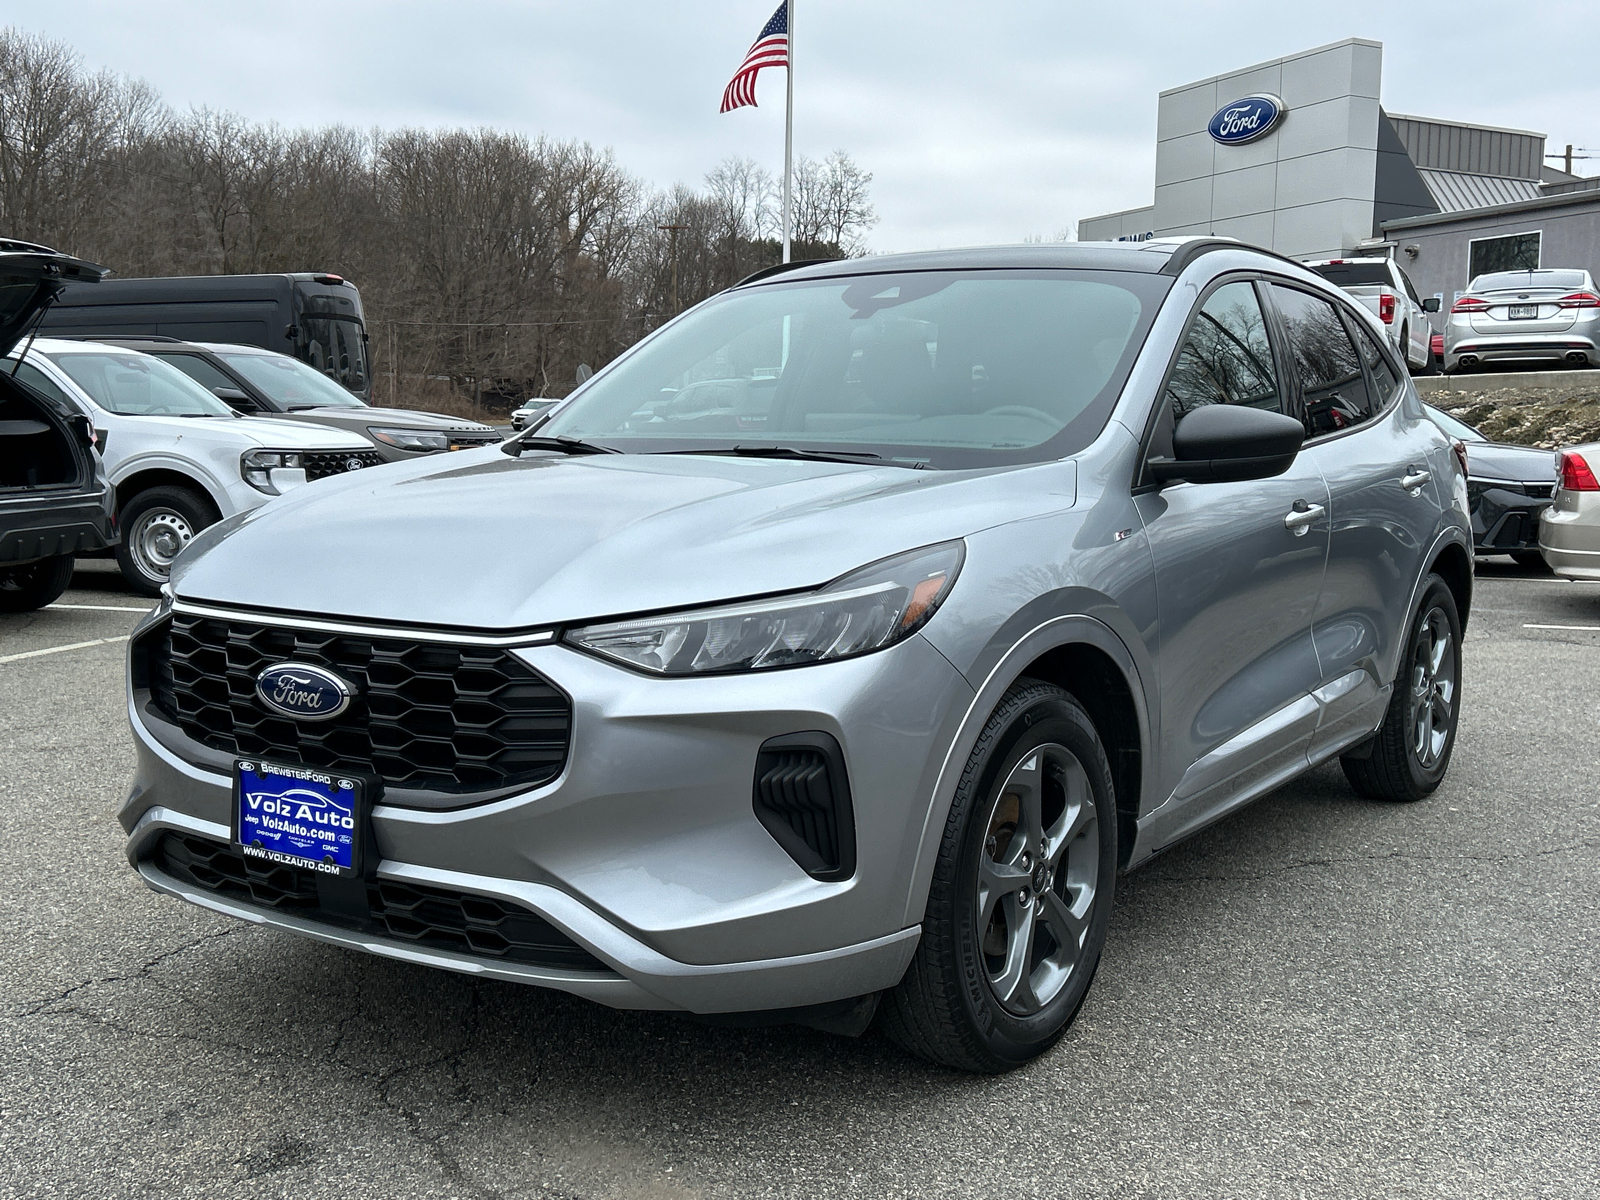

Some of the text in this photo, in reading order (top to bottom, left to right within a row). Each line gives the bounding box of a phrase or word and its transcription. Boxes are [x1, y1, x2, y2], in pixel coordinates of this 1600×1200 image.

[1219, 104, 1262, 136] Ford
[273, 674, 323, 709] Ford
[245, 813, 259, 825] Jeep
[246, 793, 354, 829] Volz Auto
[262, 815, 336, 842] VolzAuto.com
[243, 845, 340, 875] WWW.VOLZAUTO.COM
[322, 844, 339, 853] GMC
